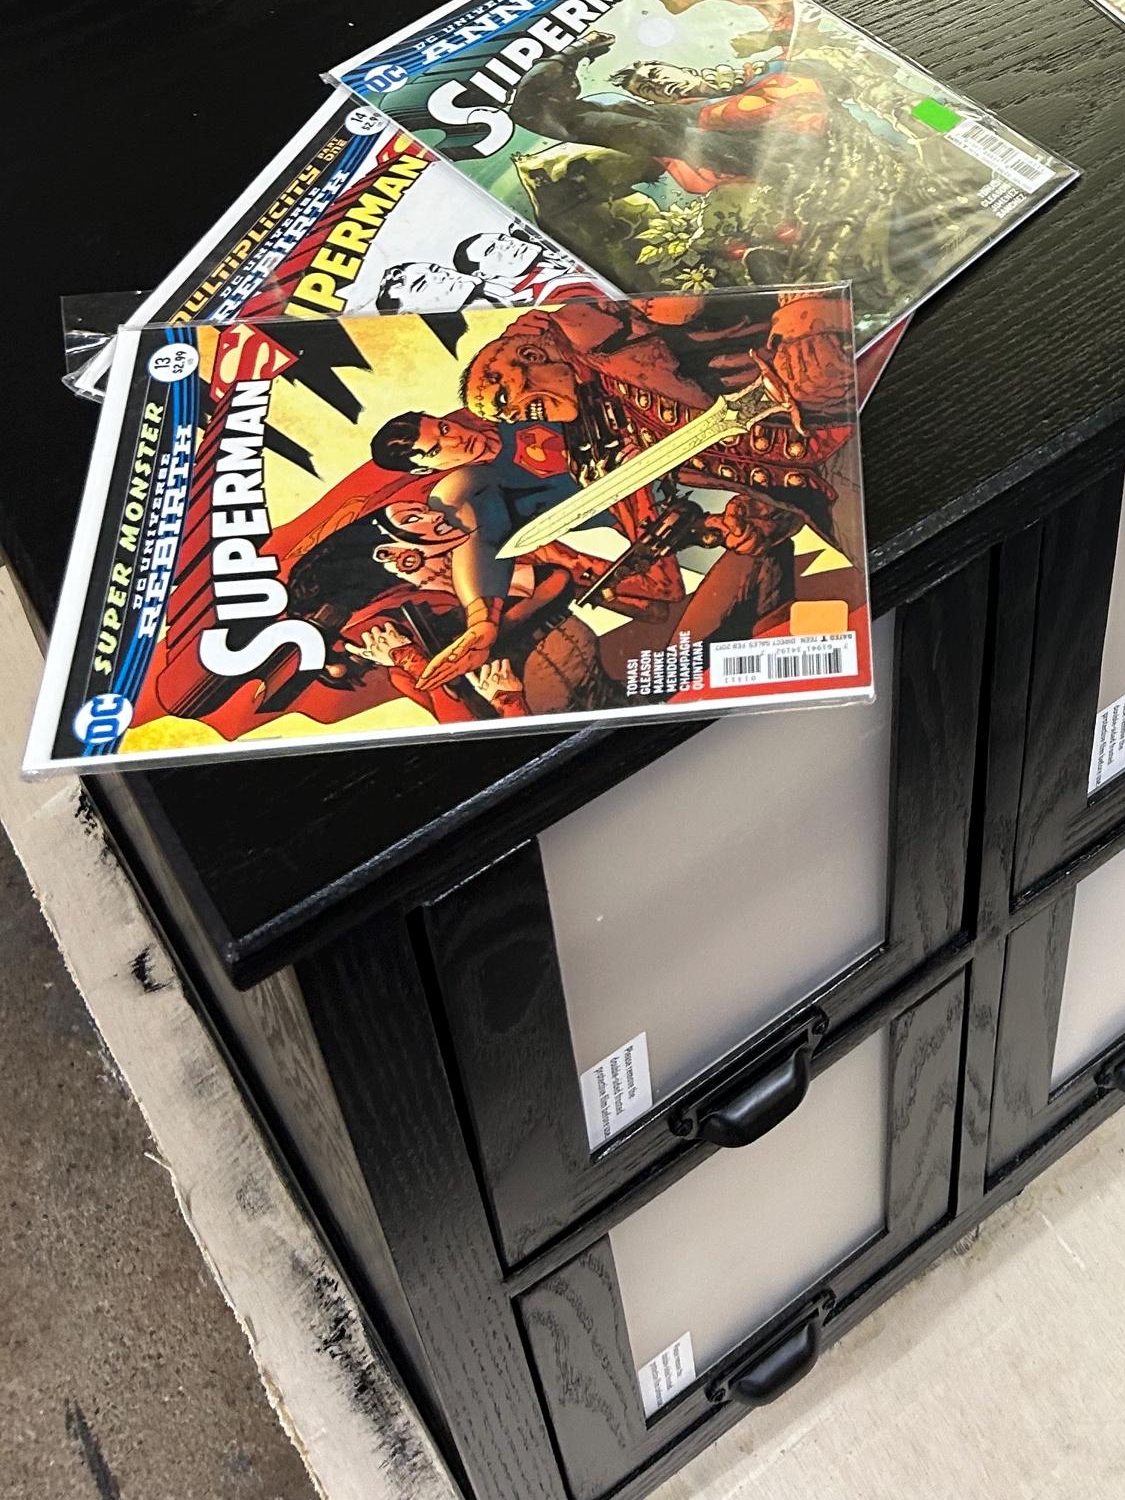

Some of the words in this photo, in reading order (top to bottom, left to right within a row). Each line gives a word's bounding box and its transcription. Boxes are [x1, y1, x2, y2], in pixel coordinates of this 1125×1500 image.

[364, 66, 407, 93] DC
[350, 112, 368, 124] 14
[317, 137, 340, 160] PART
[211, 169, 350, 324] REBIRTH
[243, 186, 321, 272] UNIVERSE
[153, 357, 172, 370] 13
[171, 350, 188, 374] $2.99
[137, 422, 194, 641] REBIRTH
[139, 452, 171, 571] UNIVERSE
[199, 378, 327, 678] SUPERMAN
[93, 558, 133, 677] SUPER
[118, 401, 166, 552] MONSTER
[132, 577, 149, 610] DC
[626, 658, 639, 697] TOMASI
[640, 649, 652, 696] GLEASON
[653, 650, 665, 694] MAHNKE
[666, 644, 678, 694] MENDOZA
[679, 630, 691, 692] CHAMPAGNE
[692, 640, 704, 691] QUINTANA
[85, 694, 129, 745] DC
